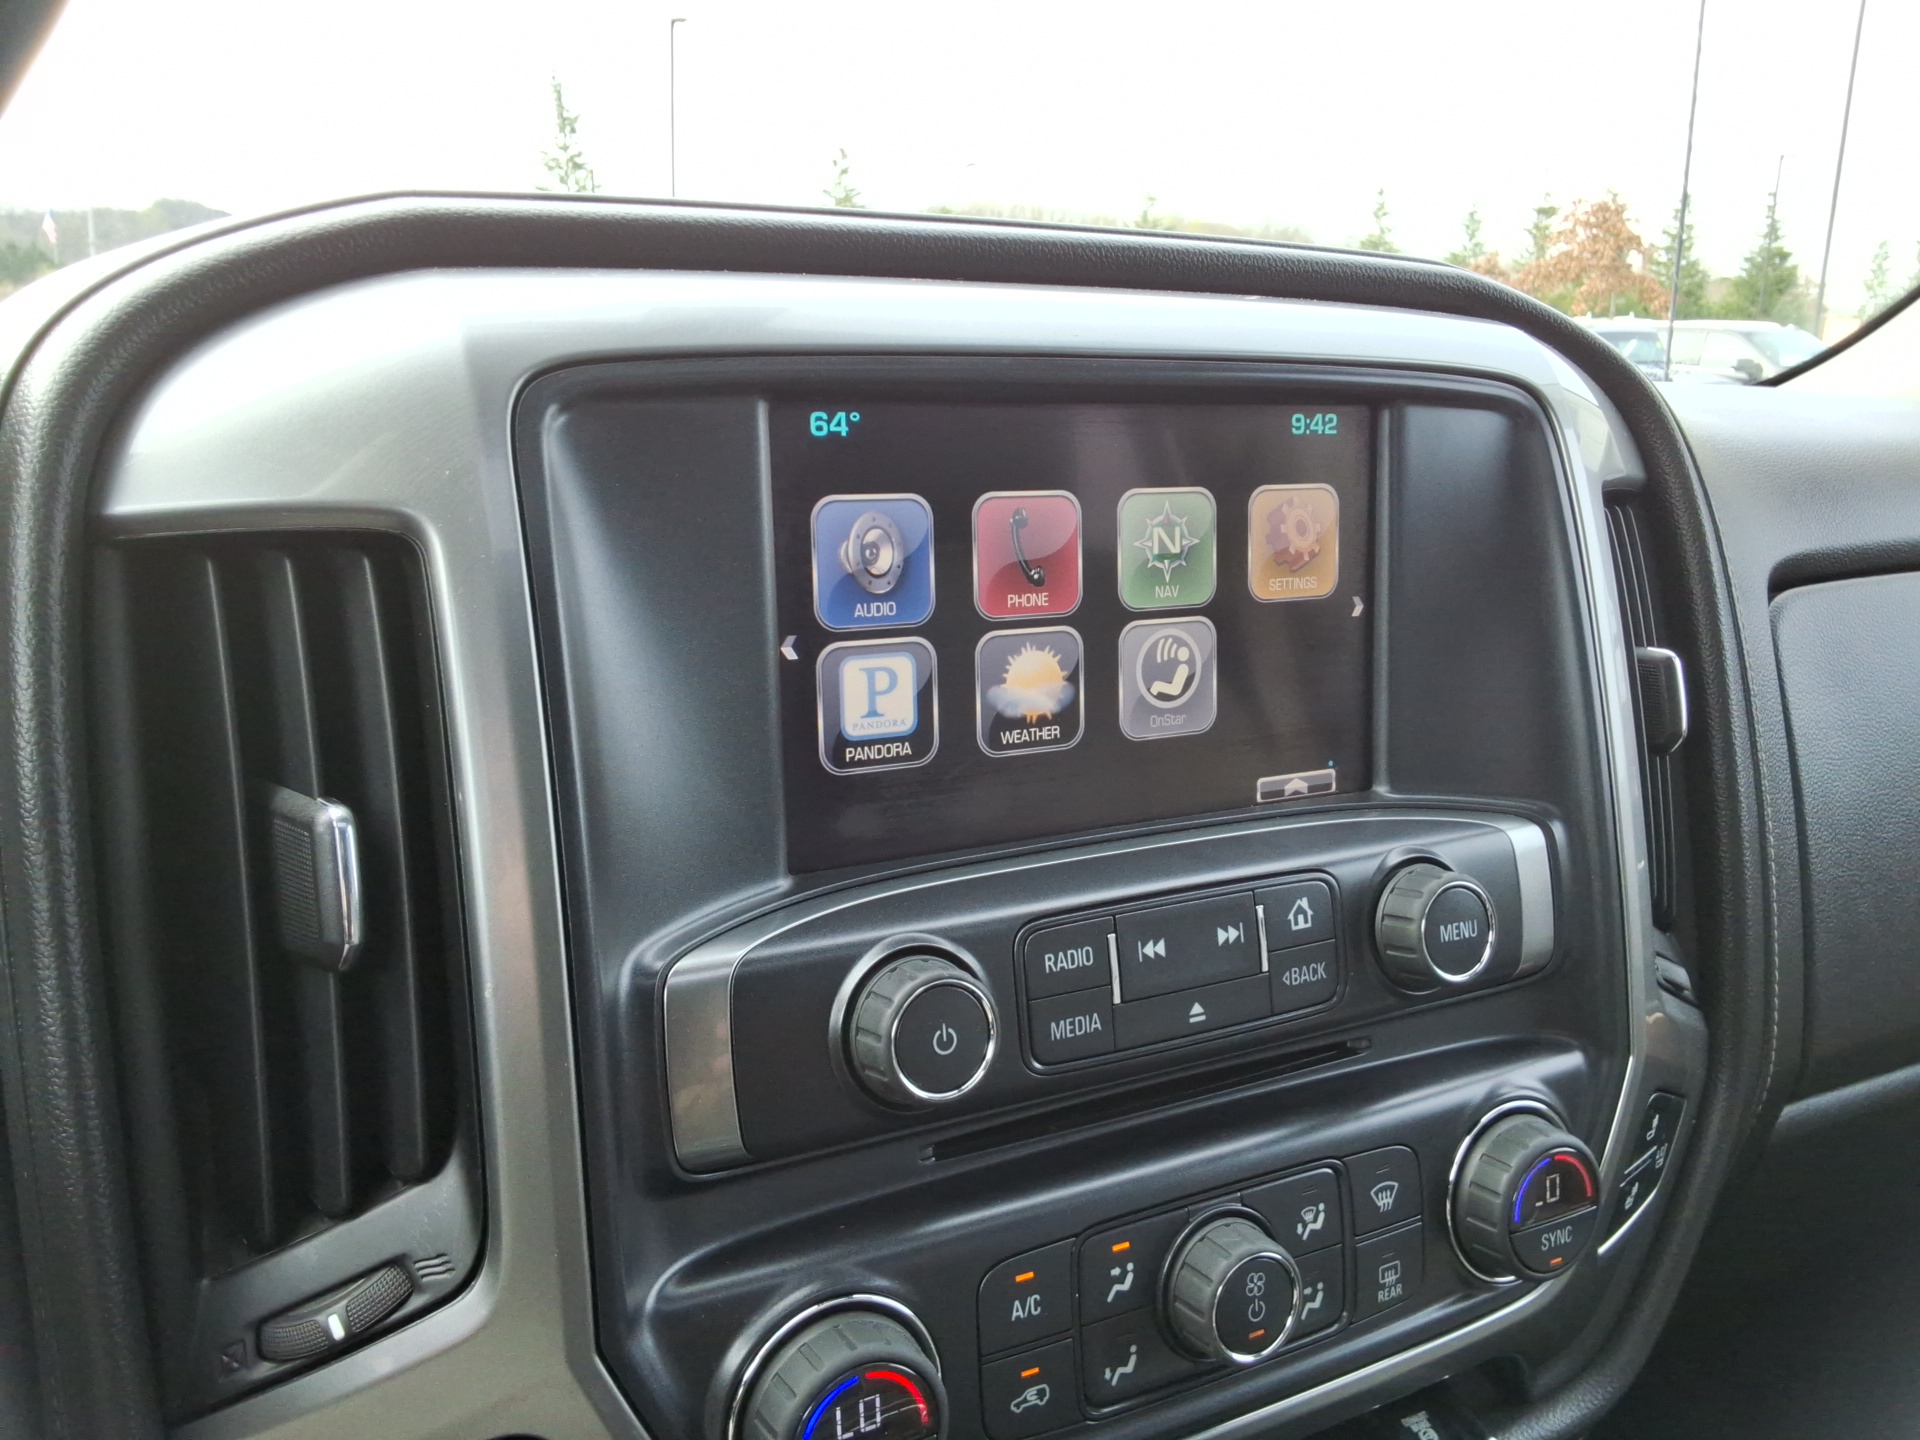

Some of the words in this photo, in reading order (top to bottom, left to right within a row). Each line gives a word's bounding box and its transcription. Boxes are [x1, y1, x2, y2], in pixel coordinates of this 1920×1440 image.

[809, 411, 860, 437] 64°
[1291, 413, 1338, 435] 9:42
[1152, 526, 1182, 555] N
[1155, 585, 1180, 598] NAV
[1269, 576, 1318, 591] SETTINGS
[854, 601, 897, 618] AUDIO
[1007, 592, 1049, 608] PHONE
[859, 666, 899, 719] P
[852, 718, 908, 731] PANDORA
[1150, 713, 1187, 728] OnStar
[1000, 725, 1061, 745] WEATHER
[845, 742, 912, 762] PANDORA
[1440, 919, 1478, 943] MENU
[1044, 946, 1094, 973] RADIO
[1291, 962, 1327, 986] BACK
[1050, 1012, 1102, 1041] MEDIA
[1541, 1226, 1573, 1251] SYNC
[1377, 1283, 1403, 1303] REAR
[1011, 1294, 1041, 1321] A/C
